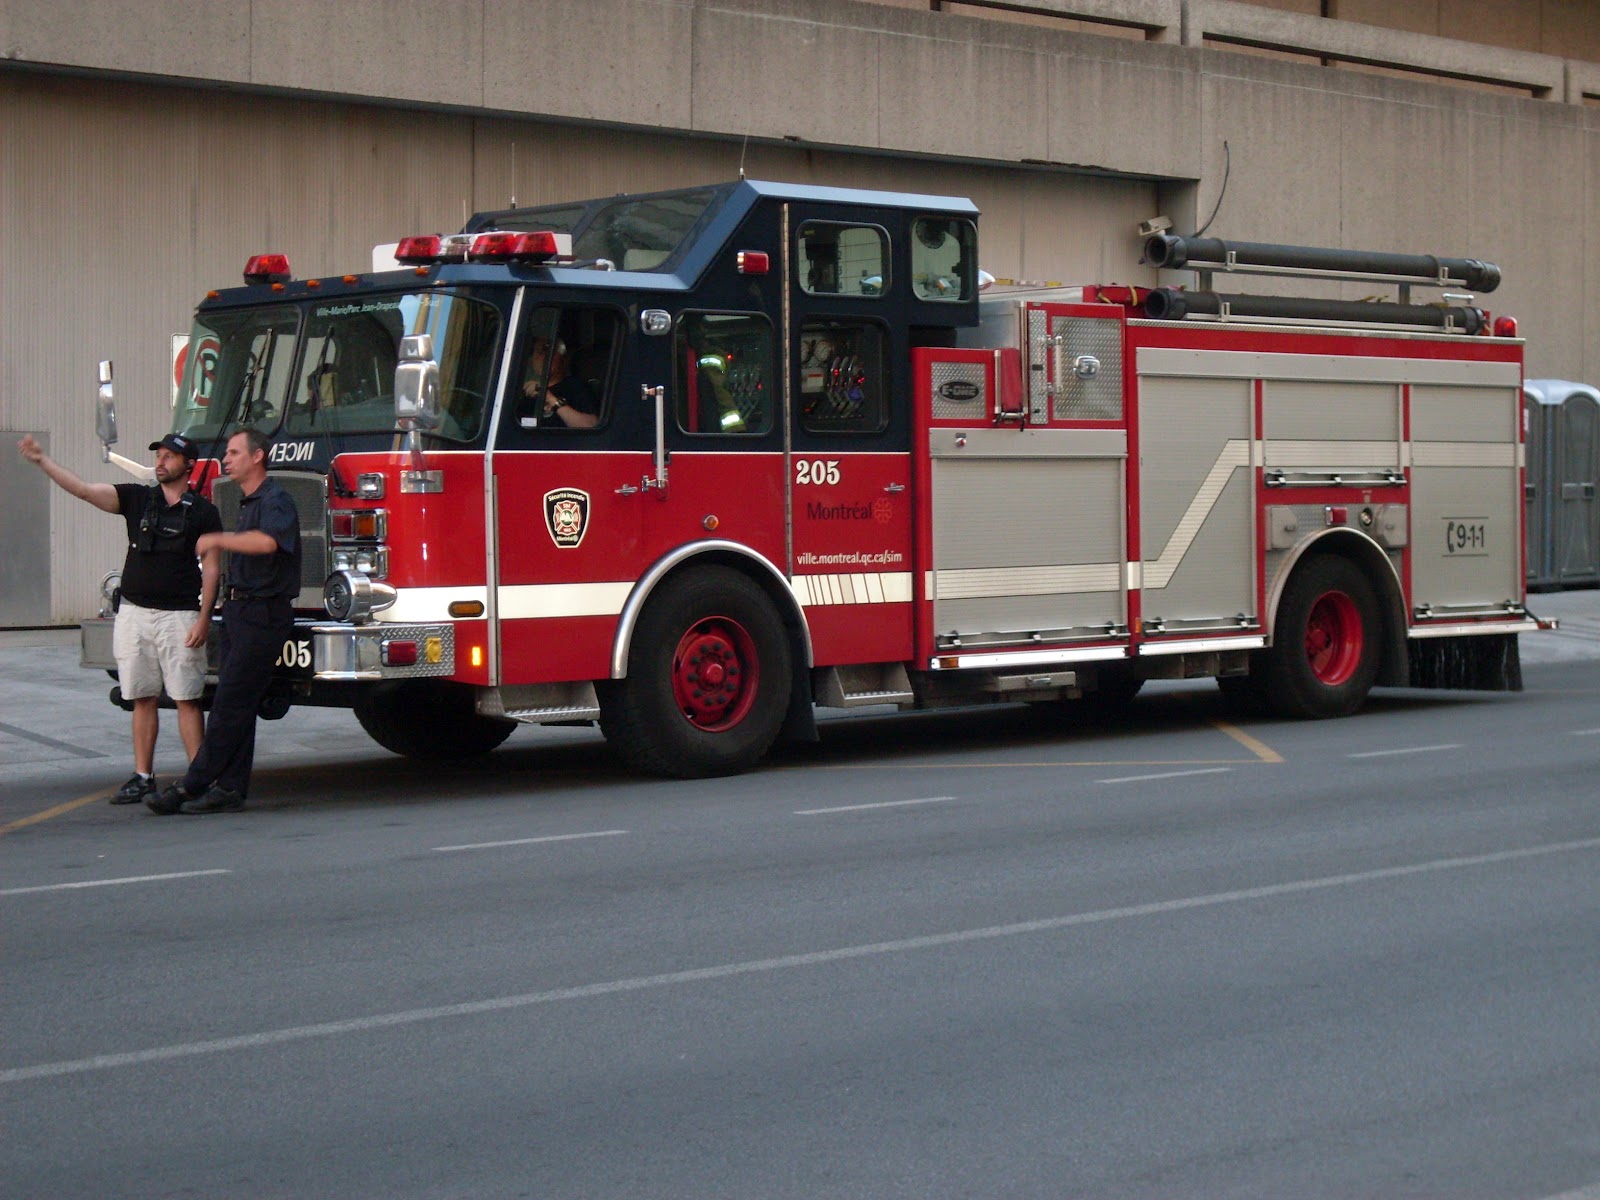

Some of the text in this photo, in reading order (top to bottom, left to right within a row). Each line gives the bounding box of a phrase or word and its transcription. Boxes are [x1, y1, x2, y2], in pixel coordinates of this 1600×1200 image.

[796, 460, 841, 485] 205
[807, 502, 873, 520] Montréal
[1457, 524, 1484, 548] 9-1-1
[797, 549, 903, 566] ville.montreal.qc.ca/sim
[275, 640, 312, 668] 05
